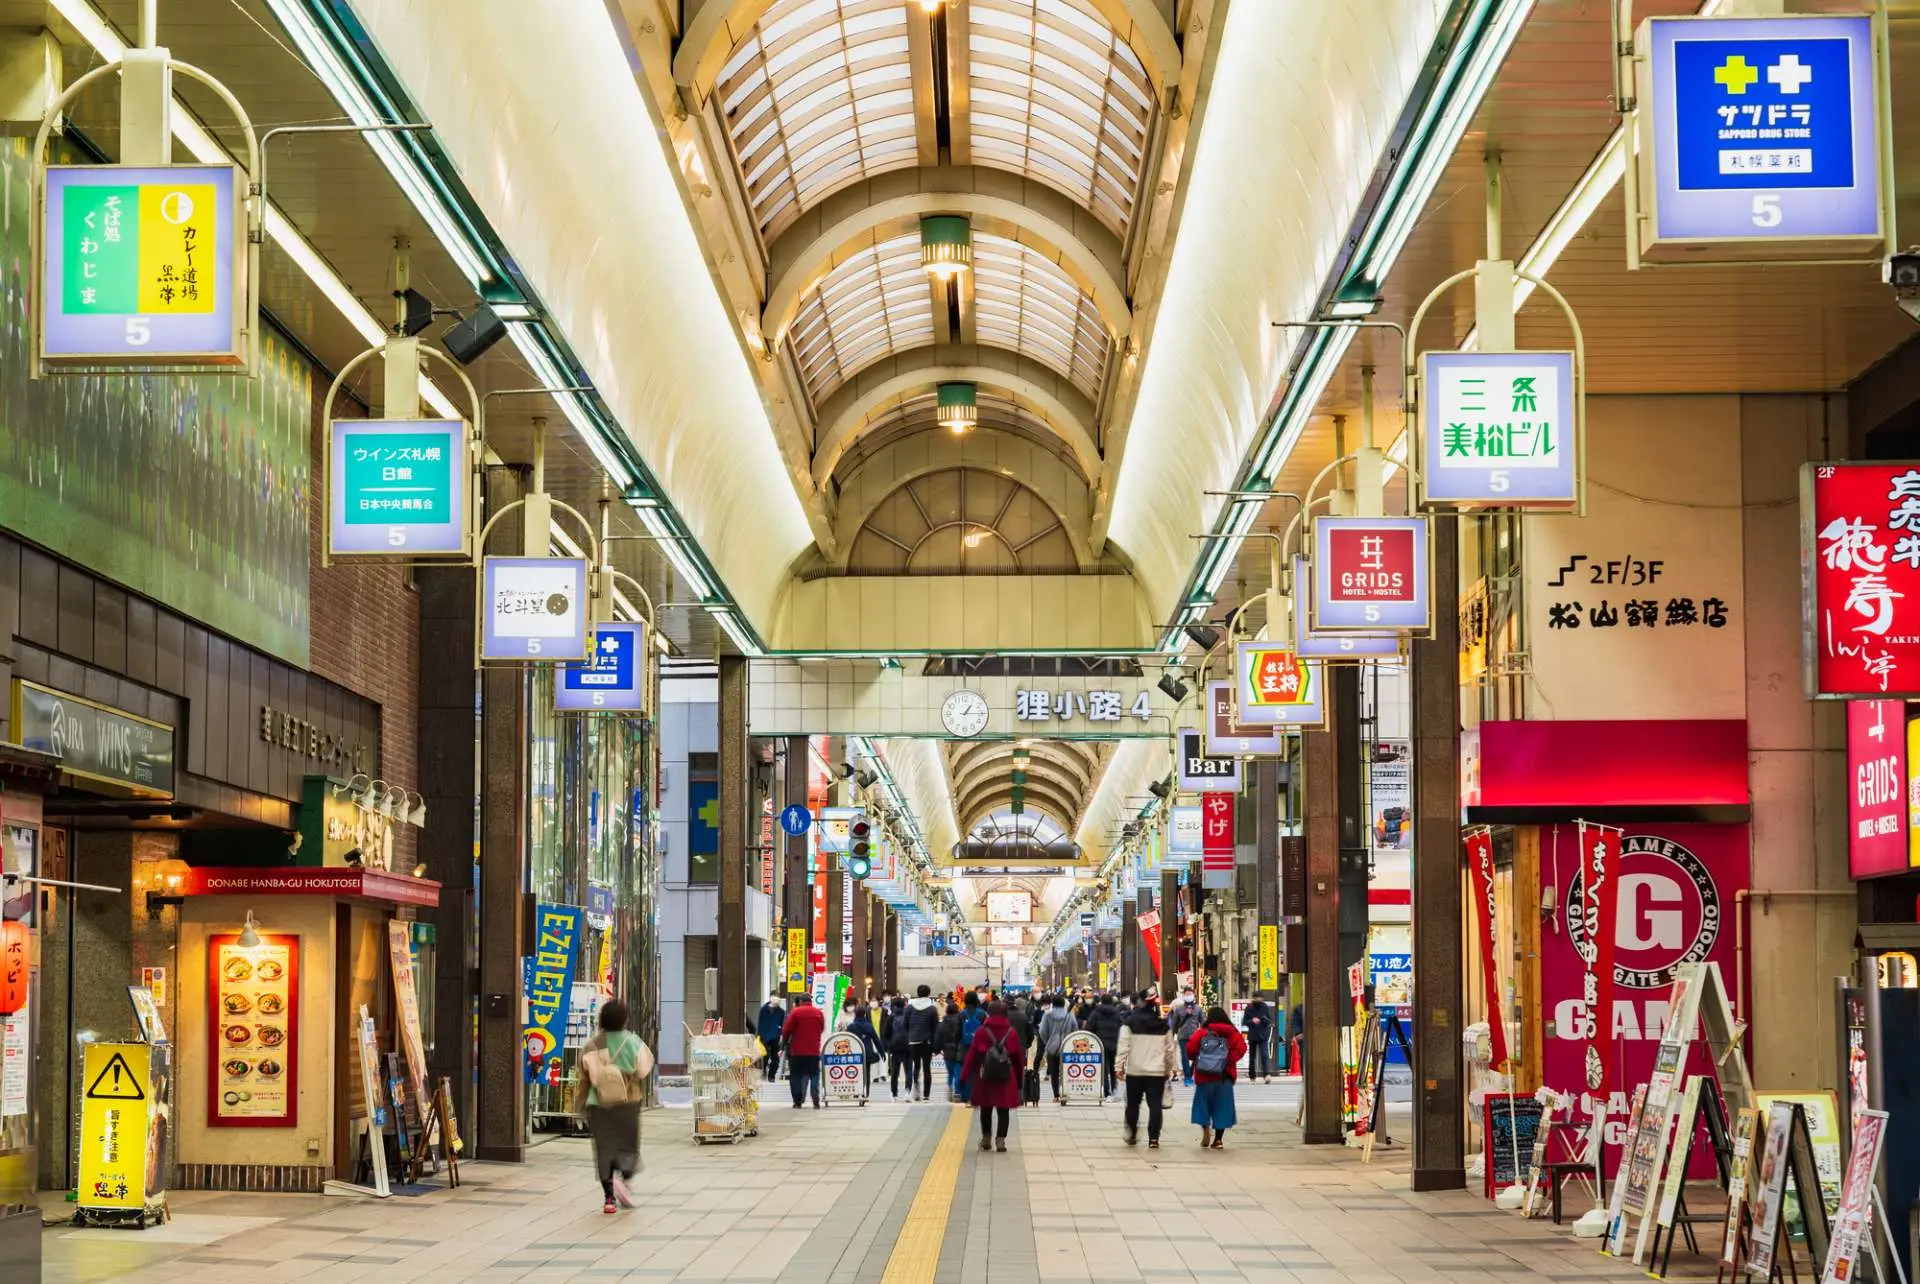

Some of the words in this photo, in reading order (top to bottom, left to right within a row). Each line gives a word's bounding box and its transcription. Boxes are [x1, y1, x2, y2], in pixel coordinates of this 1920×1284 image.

[1717, 104, 1811, 126] サツドラ
[1718, 129, 1757, 139] SAPPORO
[1758, 129, 1782, 138] DRUG
[1784, 128, 1811, 138] STORE
[104, 196, 122, 242] そば処
[1752, 194, 1782, 227] 5
[81, 211, 99, 305] くわじま
[182, 227, 198, 301] カレー道場
[125, 317, 151, 346] 5
[1443, 422, 1555, 456] 美松ビル
[353, 447, 441, 462] ウインズ札幌
[1489, 470, 1510, 492] 5
[1818, 467, 1836, 478] 2F
[360, 498, 433, 511] 日本中央競馬会
[388, 526, 406, 546] 5
[1342, 572, 1404, 588] GRIDS
[1590, 554, 1664, 586] 2F/3F
[1818, 516, 1905, 636] 徳寿
[496, 597, 546, 615] 北斗星
[1365, 605, 1380, 622] 5
[1549, 597, 1728, 629] 松山額縁店
[527, 639, 542, 654] 5
[1262, 673, 1299, 693] 王将
[593, 692, 604, 705] 5
[1275, 707, 1286, 719] 5
[66, 716, 85, 752] JRA
[1240, 739, 1250, 751] 5
[96, 717, 131, 775] WINS
[1188, 757, 1231, 774] Bar
[1857, 755, 1898, 808] GRIDS
[1208, 792, 1229, 837] やげ
[1620, 838, 1675, 857] AME
[208, 878, 248, 888] DONABE
[251, 878, 302, 888] HANBA-GU
[304, 878, 361, 888] HOKUTOSEI
[1613, 968, 1660, 986] GATE
[1667, 904, 1718, 980] SPPORO
[7, 942, 22, 1001] ホッピー
[1555, 999, 1735, 1040] GAM
